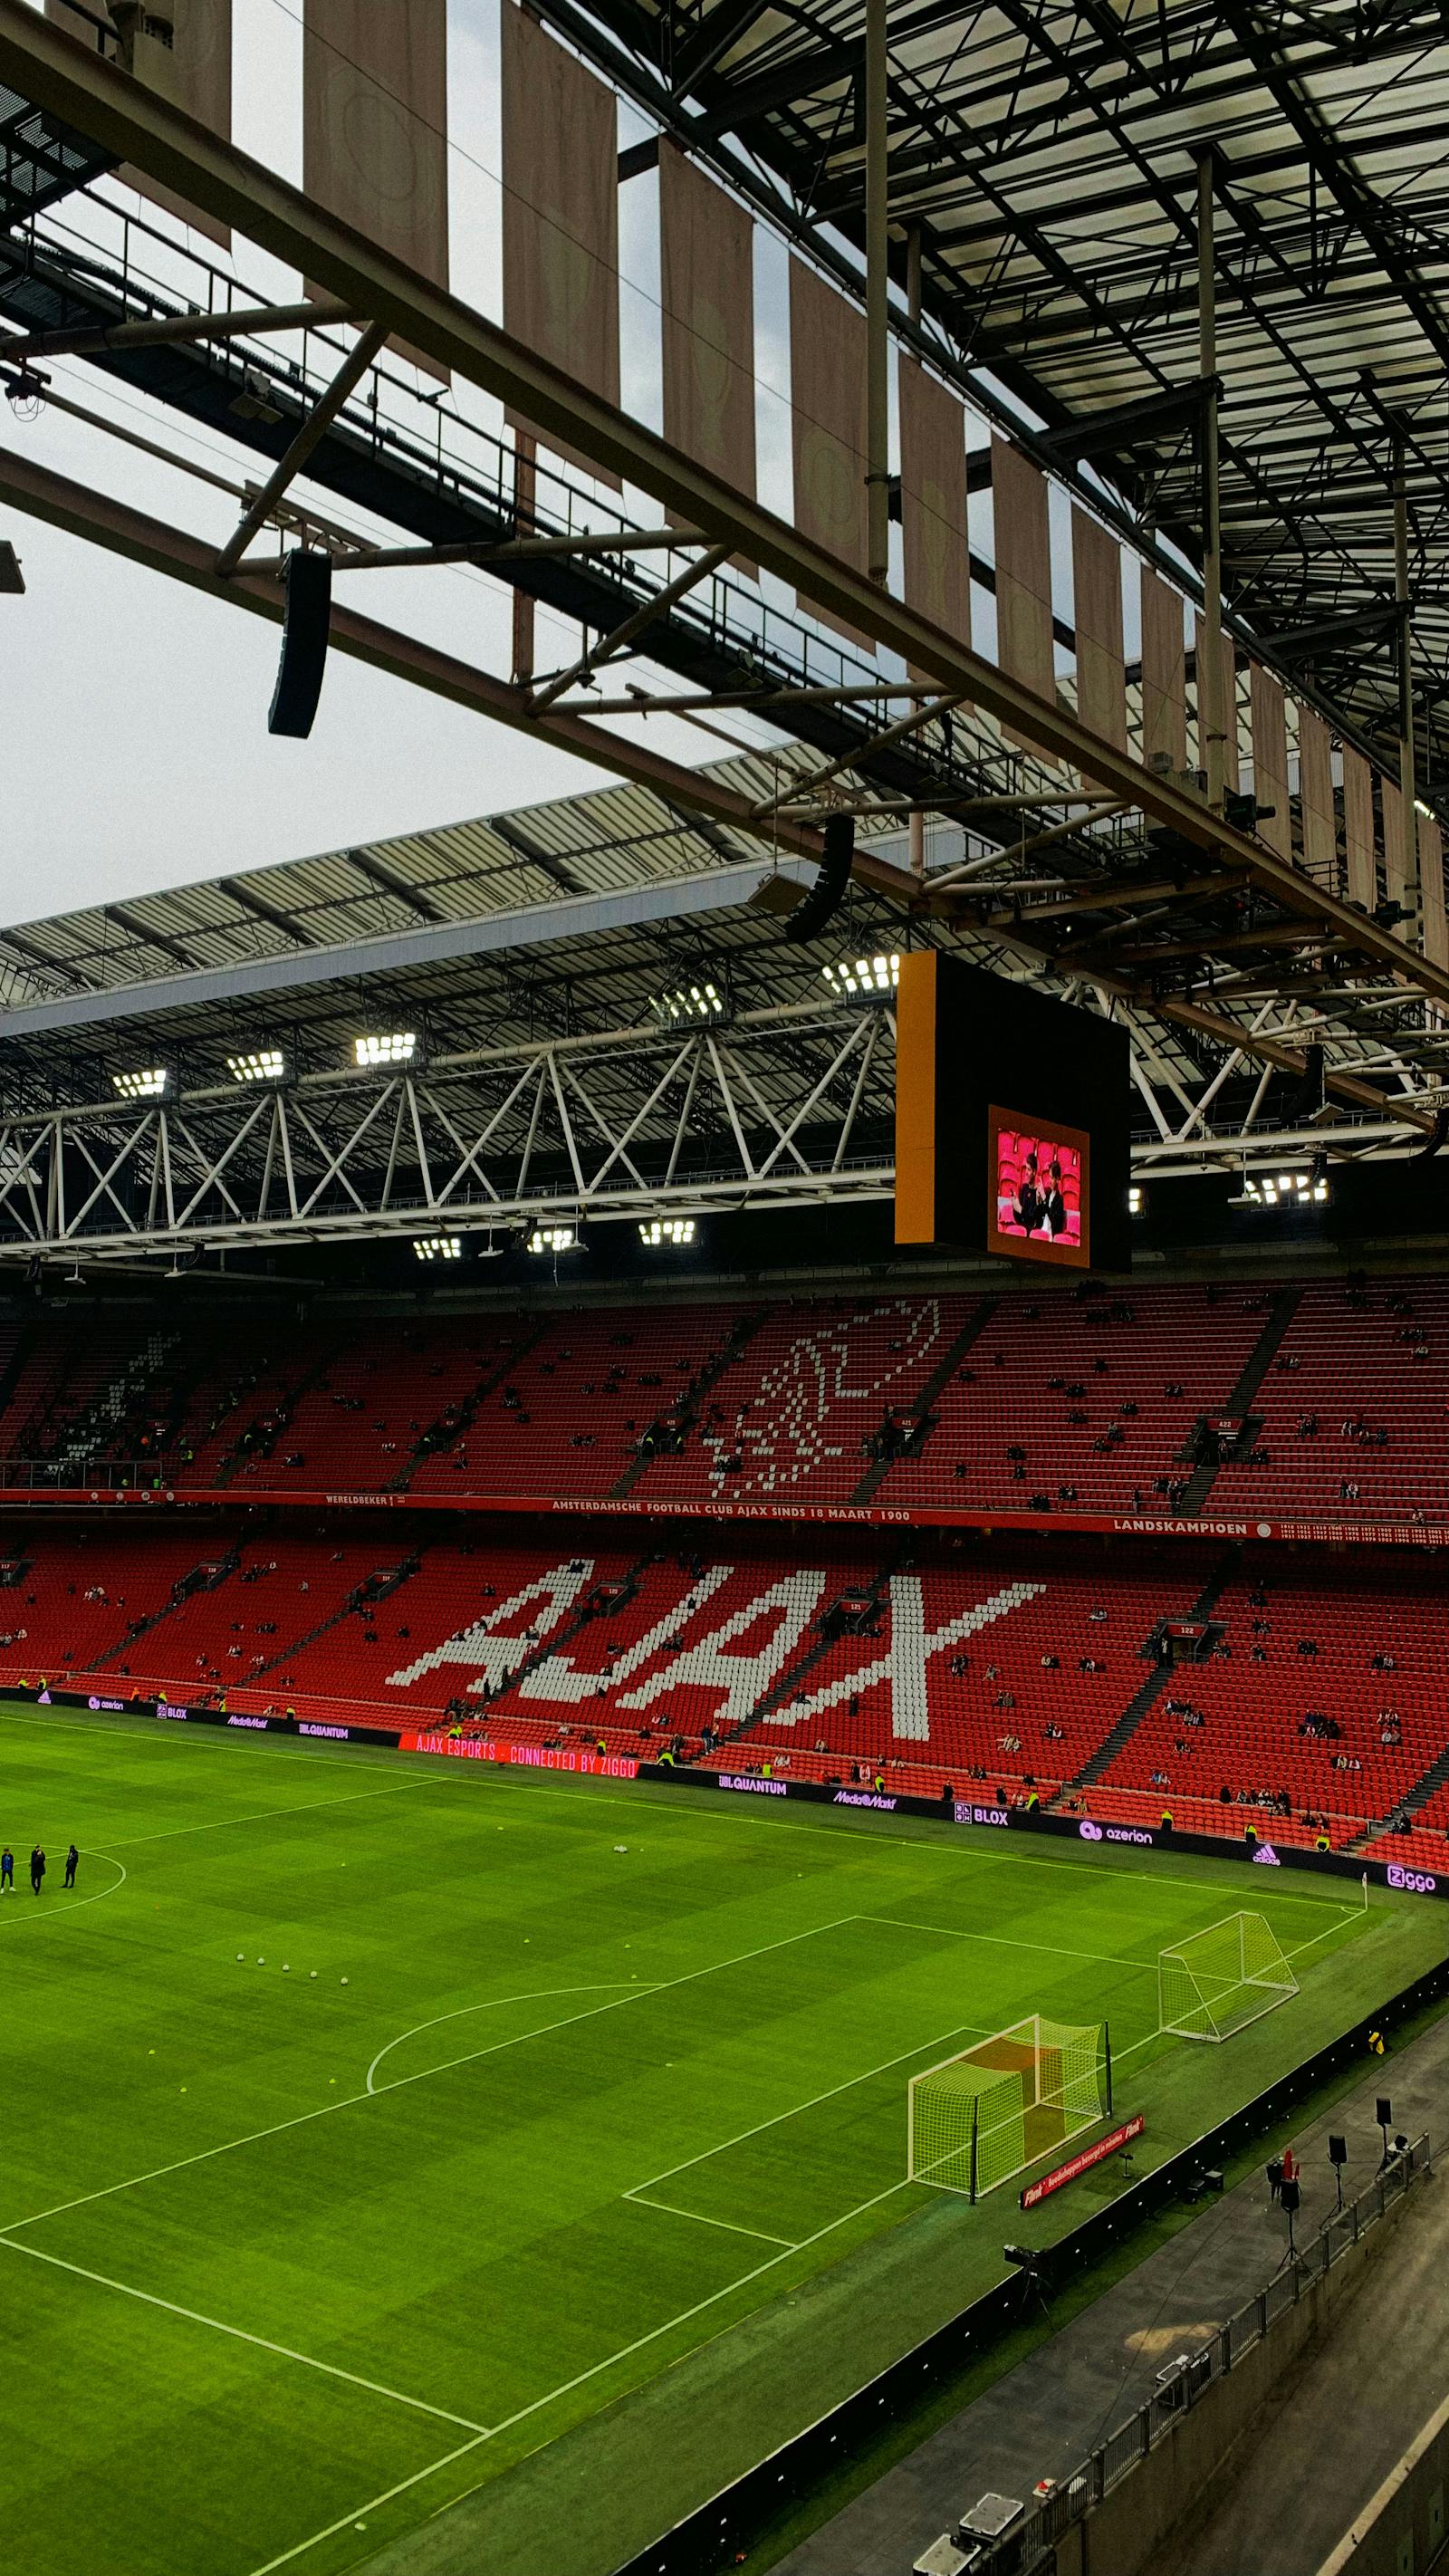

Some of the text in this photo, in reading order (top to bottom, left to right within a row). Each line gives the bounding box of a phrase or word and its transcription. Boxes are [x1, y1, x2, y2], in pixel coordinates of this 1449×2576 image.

[326, 1495, 388, 1504] WERELDBEKER
[552, 1501, 910, 1520] AMSTERDAMSCHE FOOTBALL CLUB AJAX SINDS 18 MAART 1900
[1114, 1520, 1248, 1534] LANDSKAMPIOEN
[386, 1558, 1047, 1742] AJAX
[167, 1707, 187, 1719] BLOX
[310, 1725, 349, 1739] QUANTUM
[417, 1735, 443, 1754] AJAX
[447, 1739, 495, 1761] ESPORTS
[510, 1746, 576, 1771] CONNECTED
[581, 1754, 595, 1773] BY
[601, 1756, 635, 1778] ZIGGO
[734, 1777, 787, 1795] QUANTUM
[974, 1808, 1008, 1826] BLOX
[1107, 1828, 1153, 1844] azerion
[1252, 1856, 1281, 1866] adidas
[1387, 1864, 1435, 1892] Ziggo
